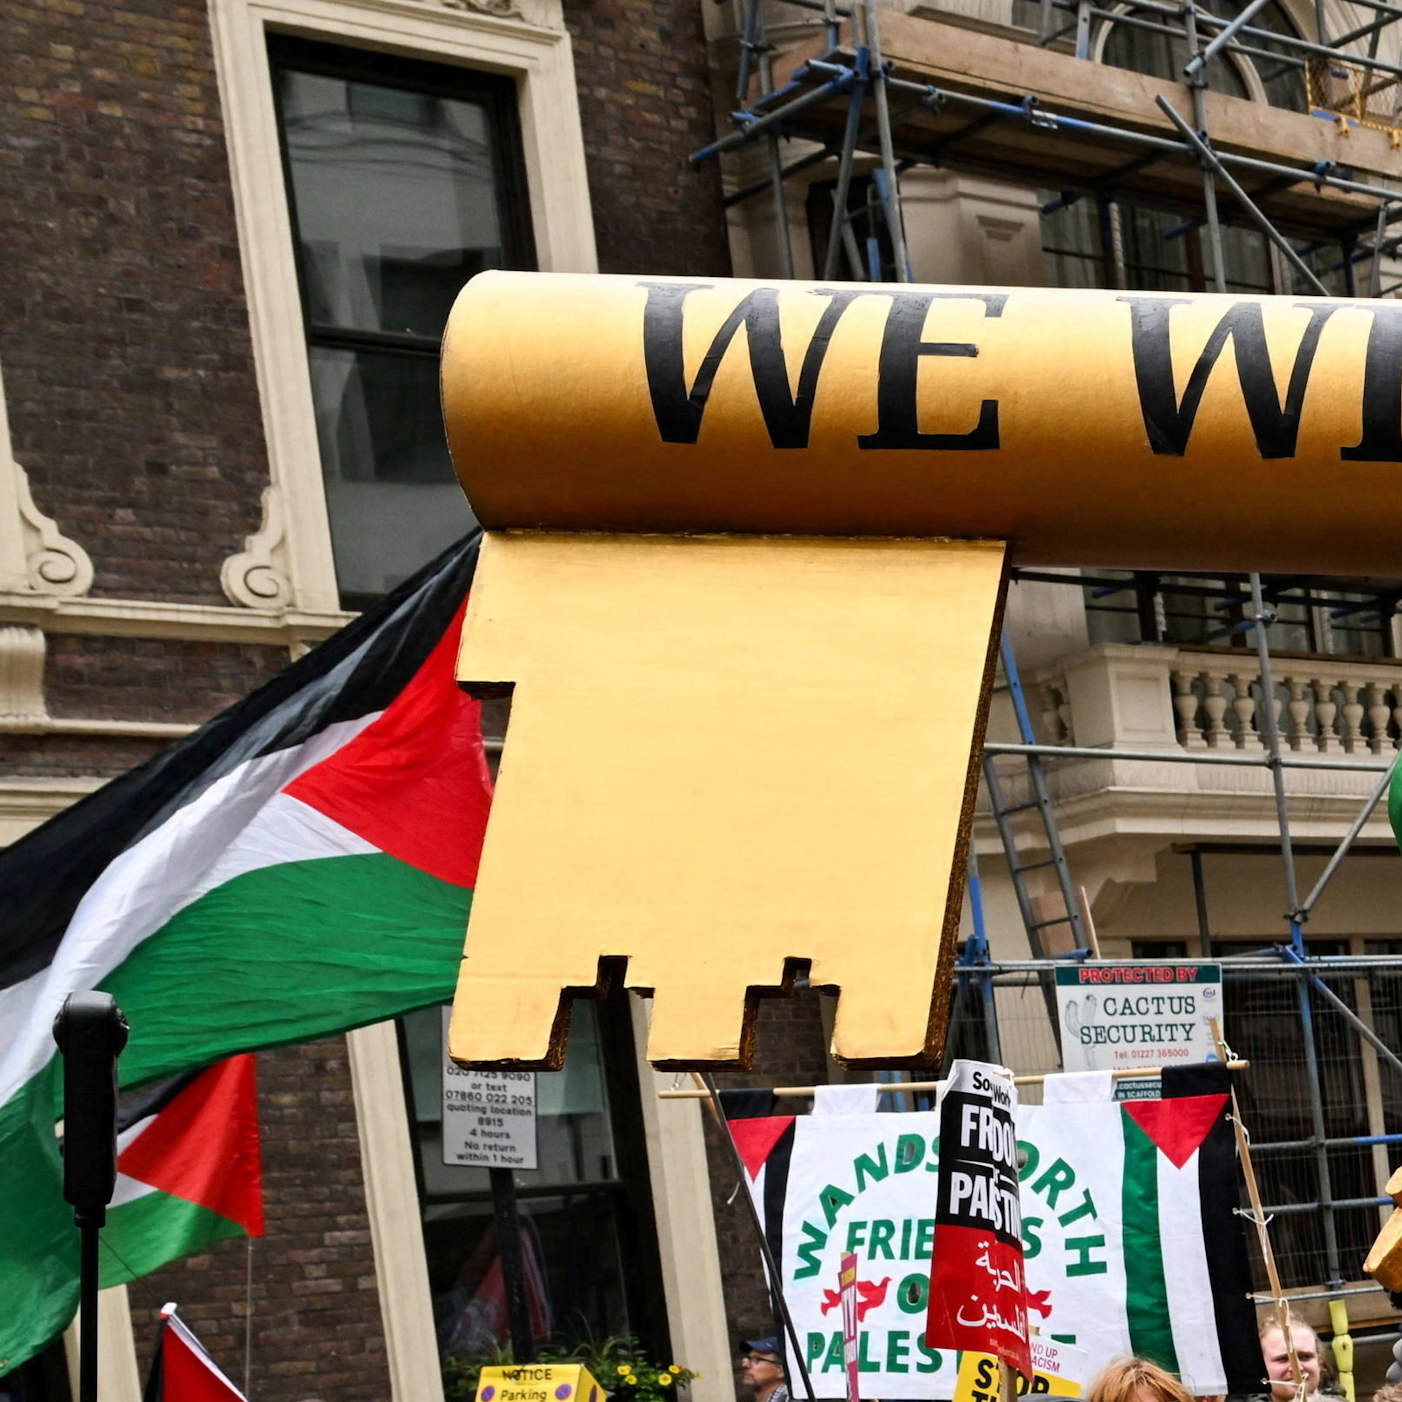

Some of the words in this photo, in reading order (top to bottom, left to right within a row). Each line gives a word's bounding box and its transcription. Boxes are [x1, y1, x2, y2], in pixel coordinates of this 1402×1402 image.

[637, 281, 1008, 450] WE
[1079, 967, 1174, 984] PROTECTED
[1176, 967, 1199, 982] BY
[1103, 995, 1197, 1017] CACTUS
[1080, 1023, 1197, 1046] SECURITY
[486, 1083, 507, 1092] text
[1128, 1090, 1161, 1099] SCAFFOLD
[446, 1103, 487, 1115] quoting
[490, 1105, 532, 1116] location
[469, 1128, 477, 1137] 4
[480, 1129, 511, 1139] hours
[464, 1141, 479, 1150] No
[483, 1142, 517, 1152] return
[456, 1152, 489, 1162] within
[500, 1154, 524, 1164] hour
[847, 1216, 1043, 1260] FRIES
[1045, 1346, 1058, 1359] UP
[1032, 1356, 1061, 1374] ACISM
[502, 1368, 552, 1381] NOTICE
[500, 1389, 547, 1402] Parking
